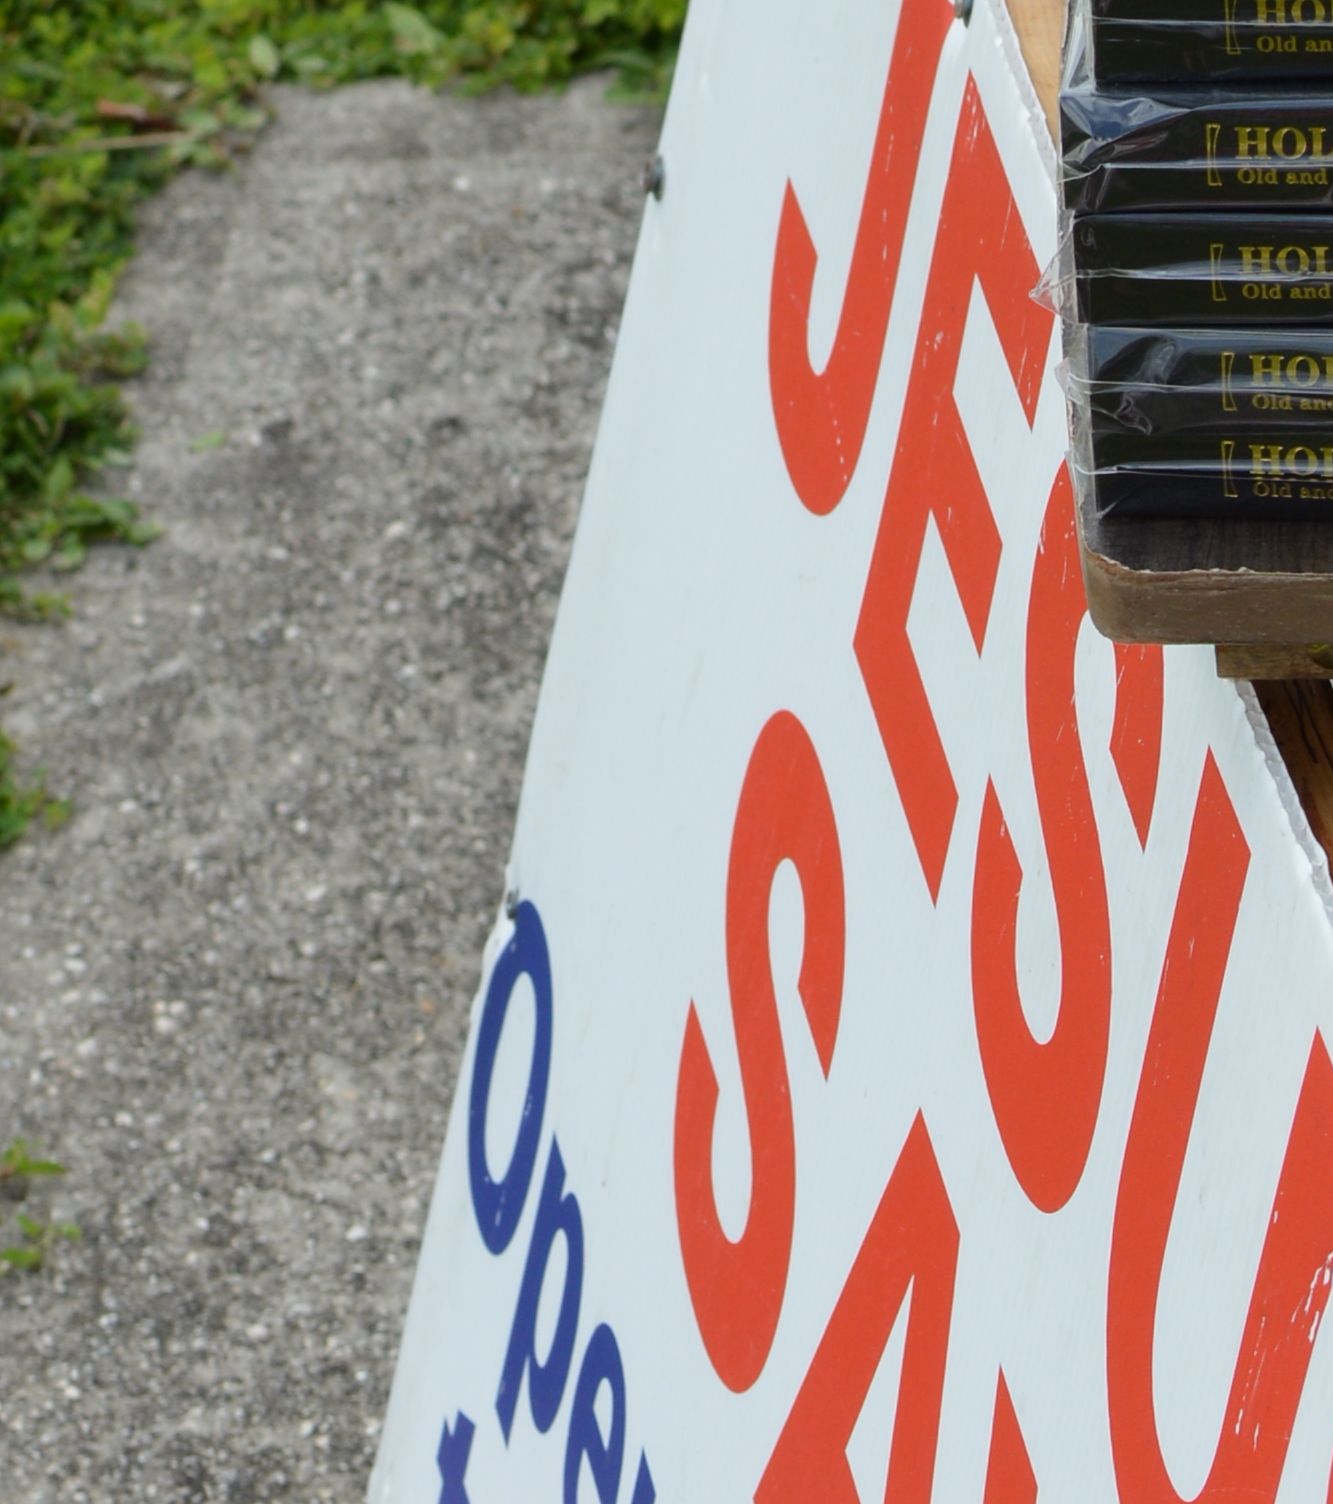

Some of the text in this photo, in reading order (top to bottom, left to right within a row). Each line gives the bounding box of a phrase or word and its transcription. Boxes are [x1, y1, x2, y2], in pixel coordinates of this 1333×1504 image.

[1257, 35, 1296, 53] Old
[1237, 167, 1277, 187] Old
[1287, 167, 1327, 187] and
[1242, 284, 1282, 301] Old
[1287, 284, 1328, 301] and
[1253, 396, 1292, 412] Old
[1253, 482, 1293, 499] Old
